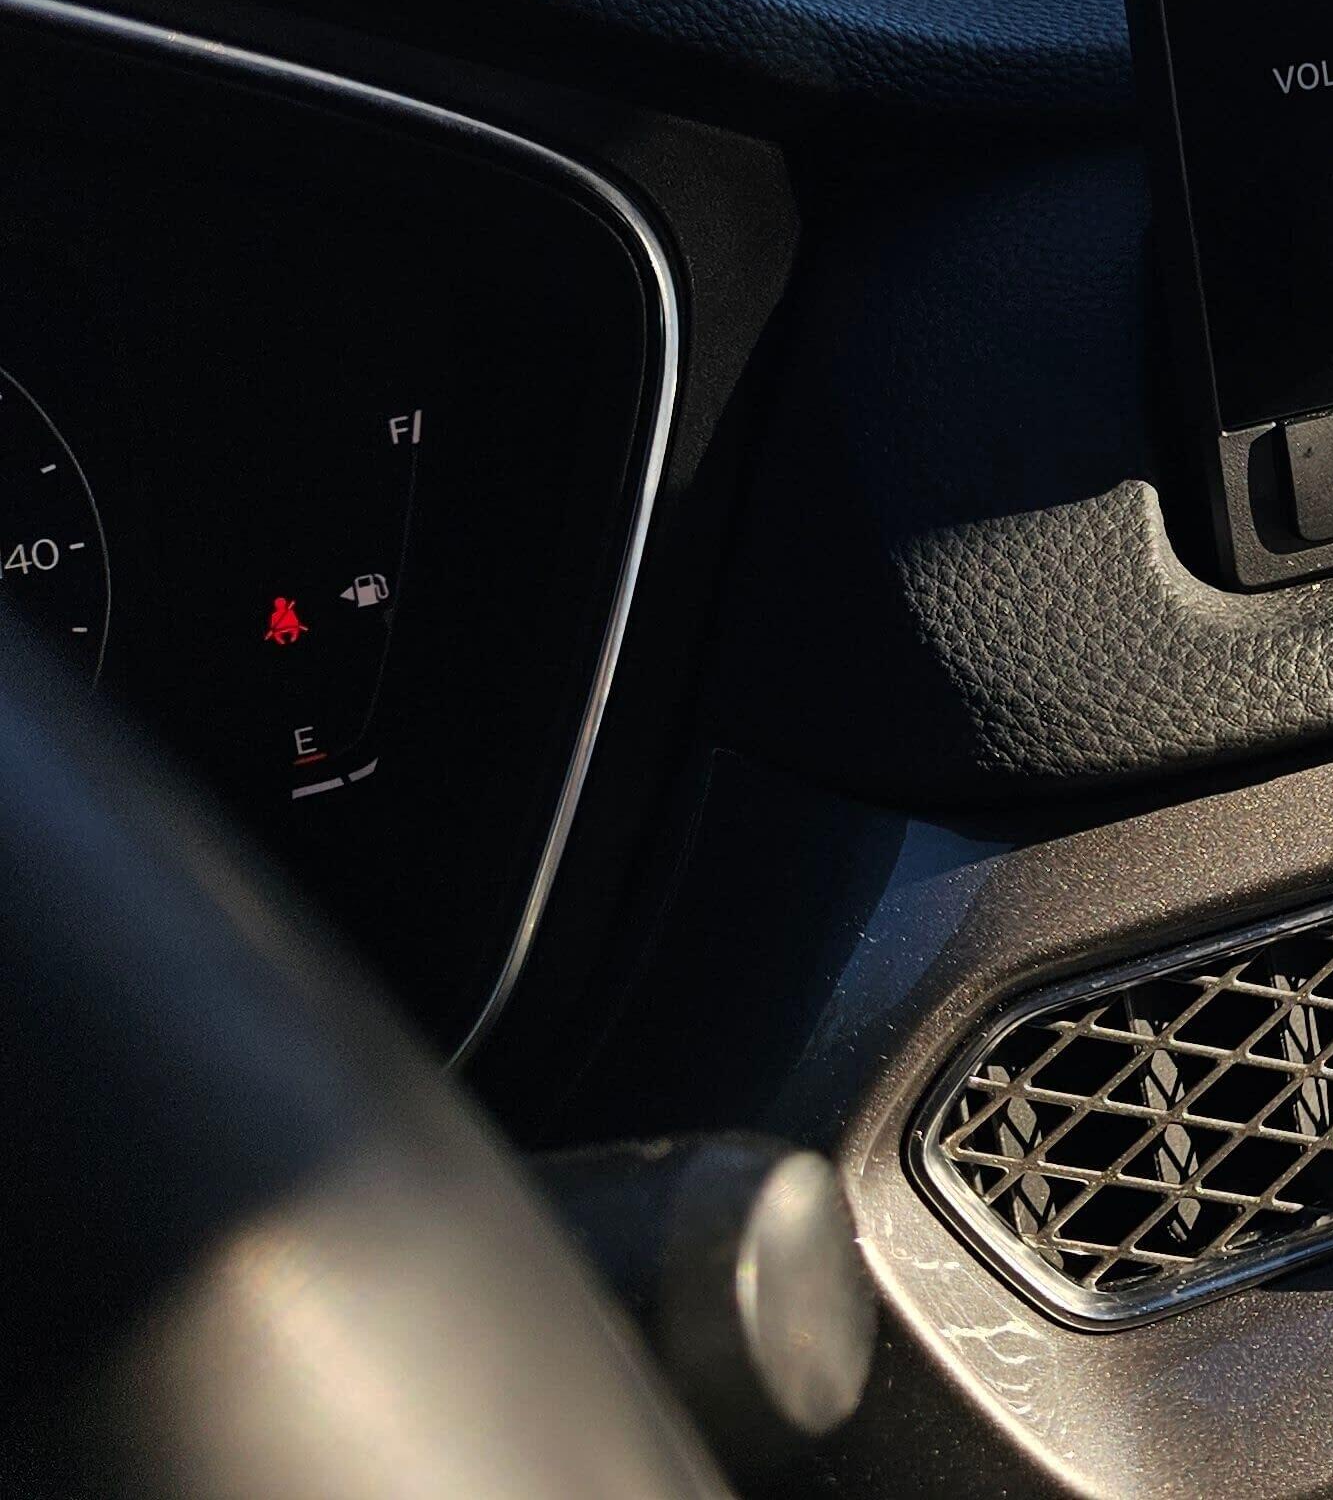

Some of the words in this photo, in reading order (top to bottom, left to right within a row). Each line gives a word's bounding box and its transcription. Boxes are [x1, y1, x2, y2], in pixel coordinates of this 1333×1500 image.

[388, 414, 410, 446] F
[0, 537, 60, 580] 40
[293, 725, 319, 756] E
